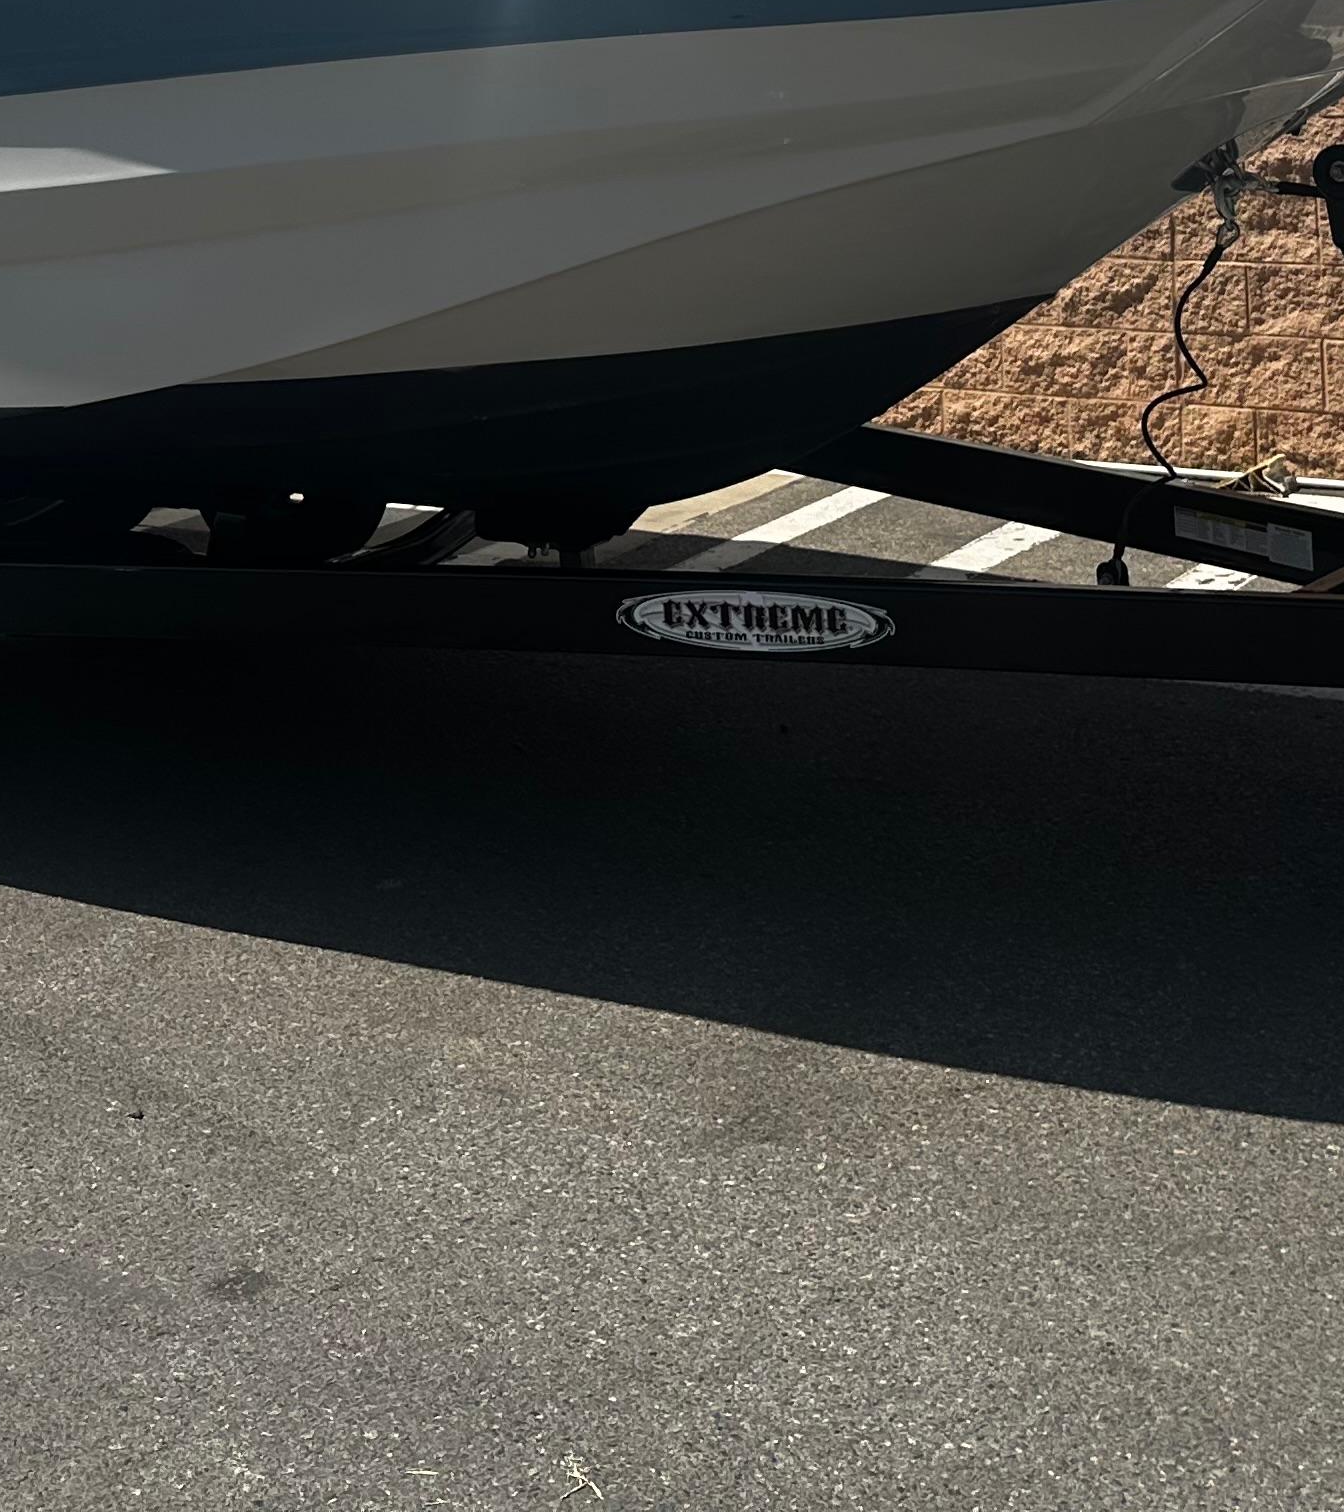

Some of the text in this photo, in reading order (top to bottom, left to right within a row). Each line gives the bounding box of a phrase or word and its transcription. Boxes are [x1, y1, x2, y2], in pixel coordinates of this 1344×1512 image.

[662, 599, 848, 635] EXTREME
[685, 630, 826, 645] CUSTOM TRAILERS
